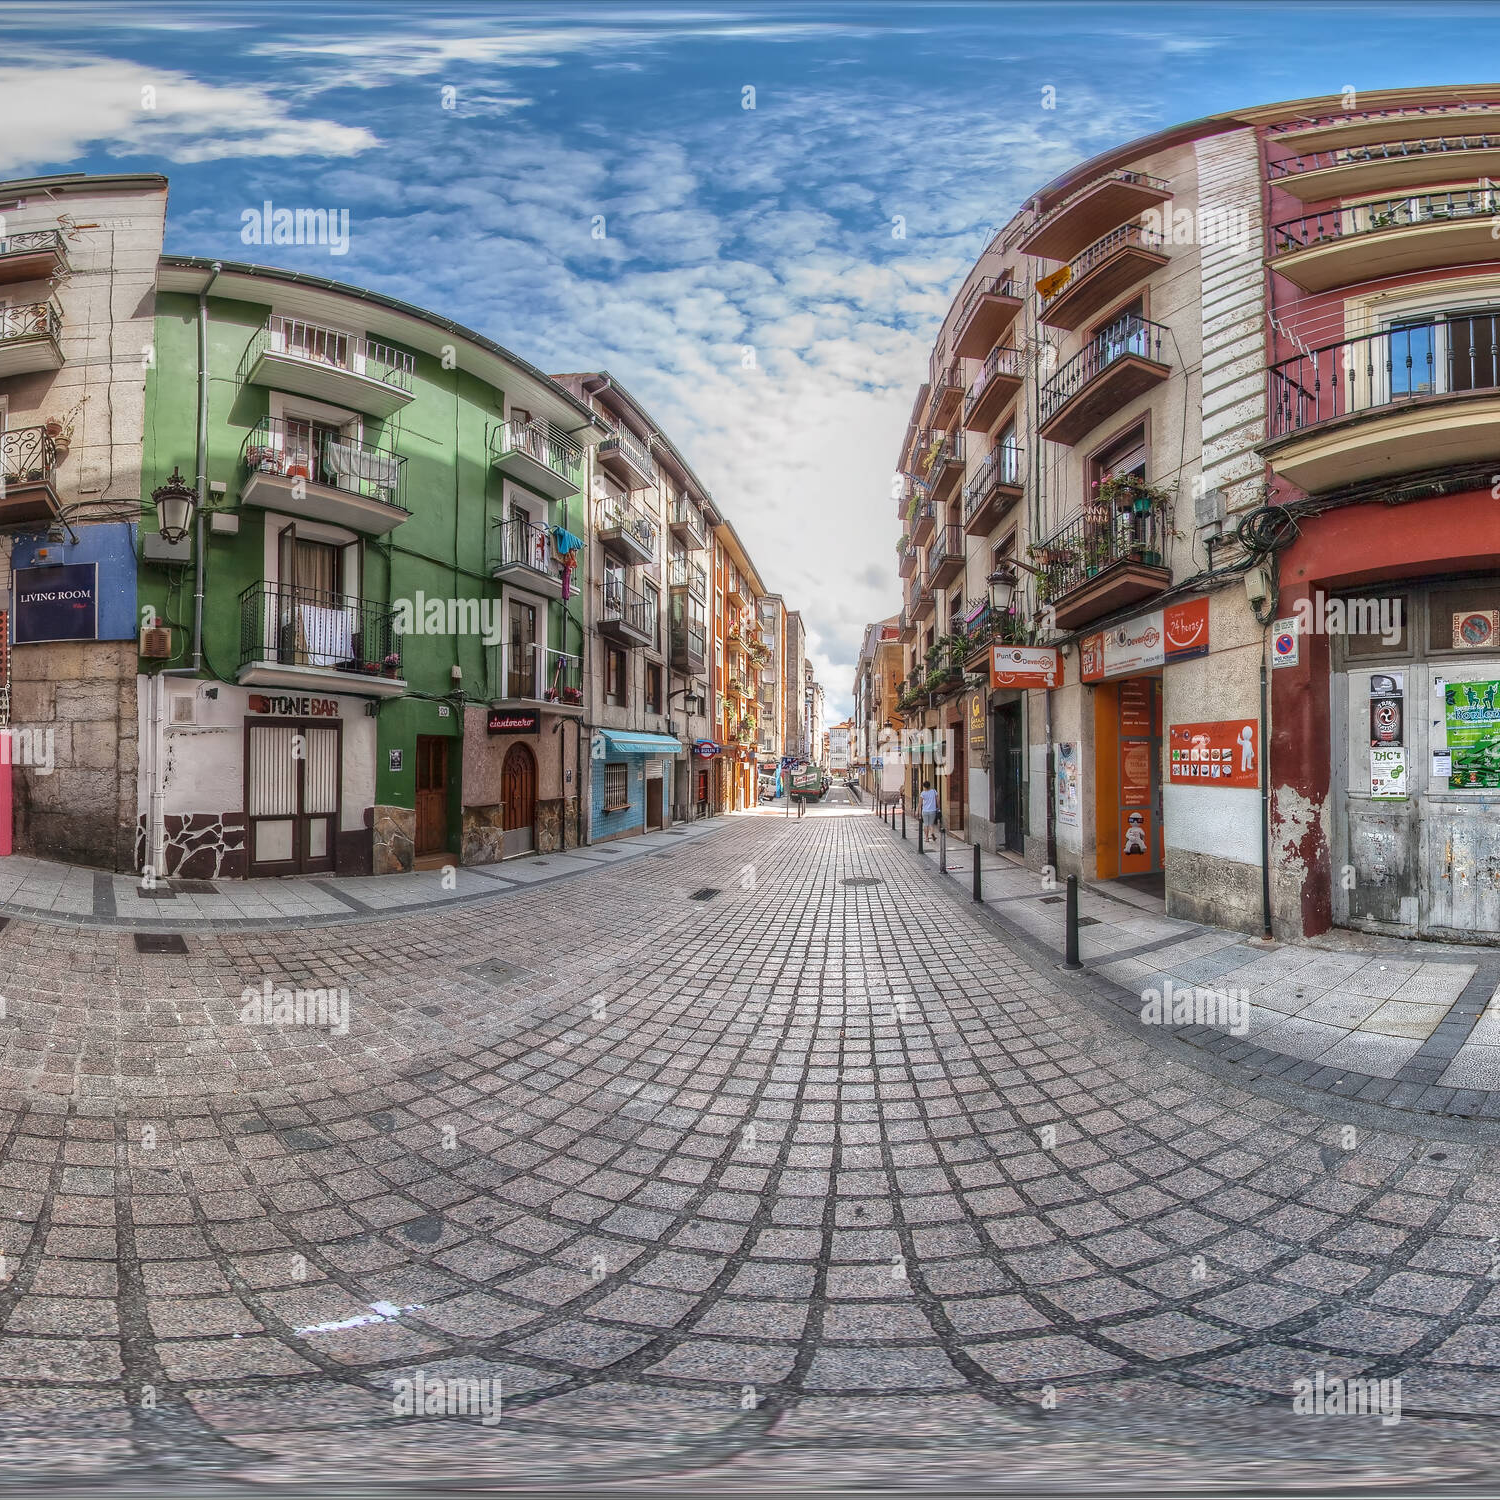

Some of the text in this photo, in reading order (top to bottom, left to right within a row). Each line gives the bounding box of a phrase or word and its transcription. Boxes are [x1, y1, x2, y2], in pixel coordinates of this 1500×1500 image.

[21, 590, 92, 603] LIVING ROOM
[1170, 617, 1200, 636] 24 horas
[1023, 658, 1054, 669] Devending
[260, 696, 339, 716] STONE BAR
